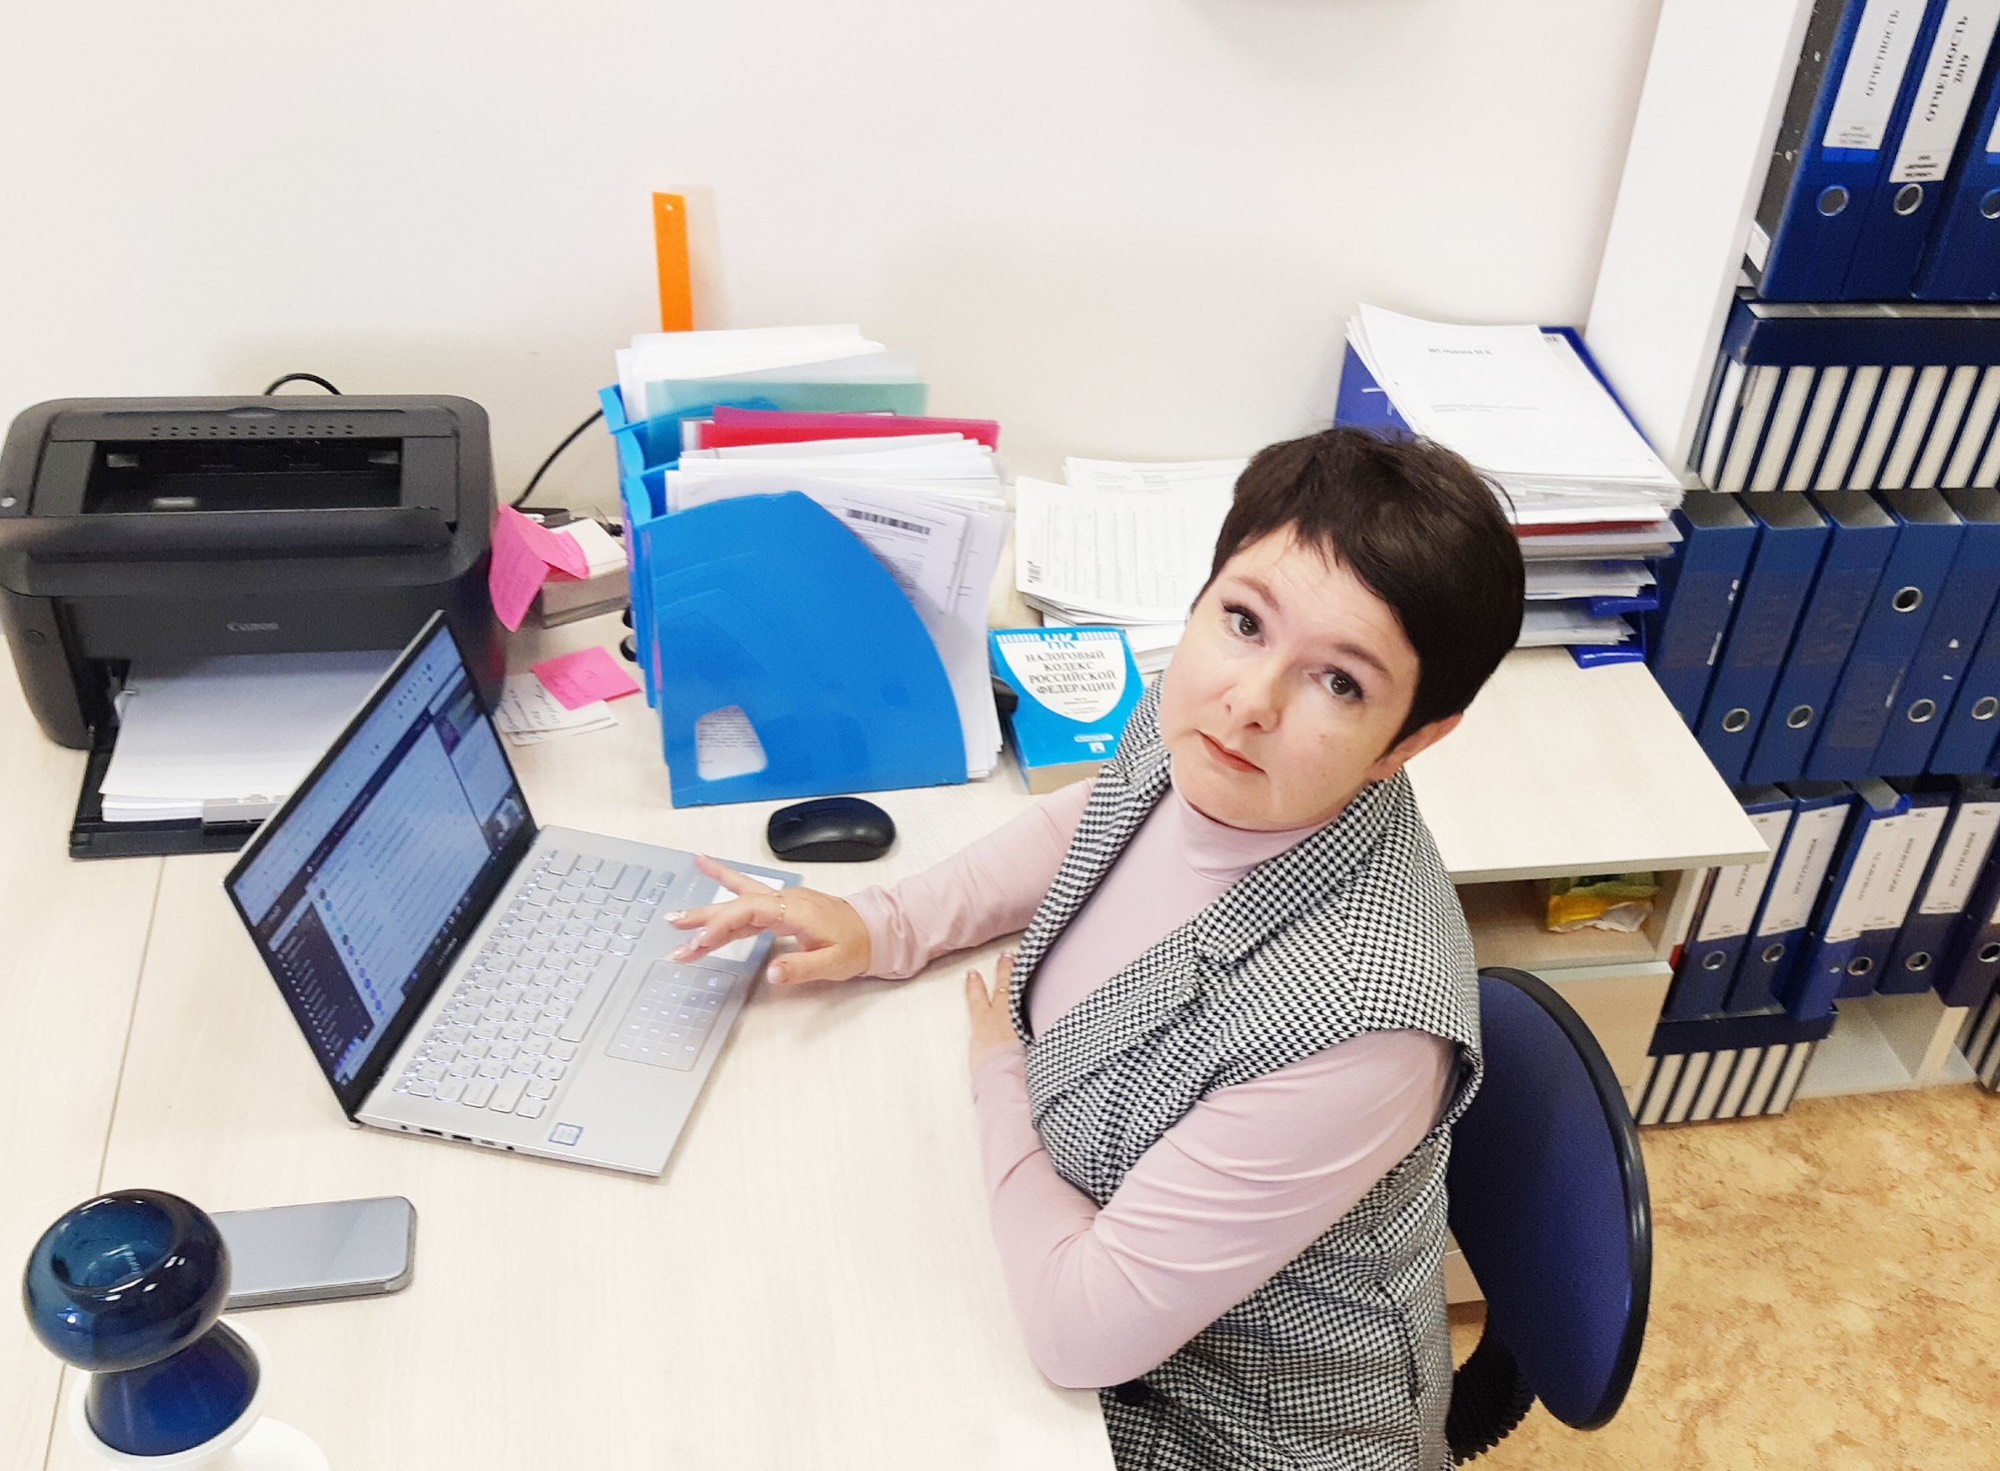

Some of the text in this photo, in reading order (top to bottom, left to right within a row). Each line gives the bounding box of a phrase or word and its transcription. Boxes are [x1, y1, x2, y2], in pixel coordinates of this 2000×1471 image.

[1925, 15, 1969, 122] ОТЧЕТНОСТЬ
[1953, 54, 1971, 84] 2019
[1043, 632, 1077, 650] НК
[1025, 650, 1106, 662] НАЛОГОВЫЙ
[1043, 661, 1095, 672] КОДЕКС
[1029, 669, 1117, 684] РОССИЙСКОЙ
[1036, 682, 1117, 695] ФЕДЕРАЦИИ
